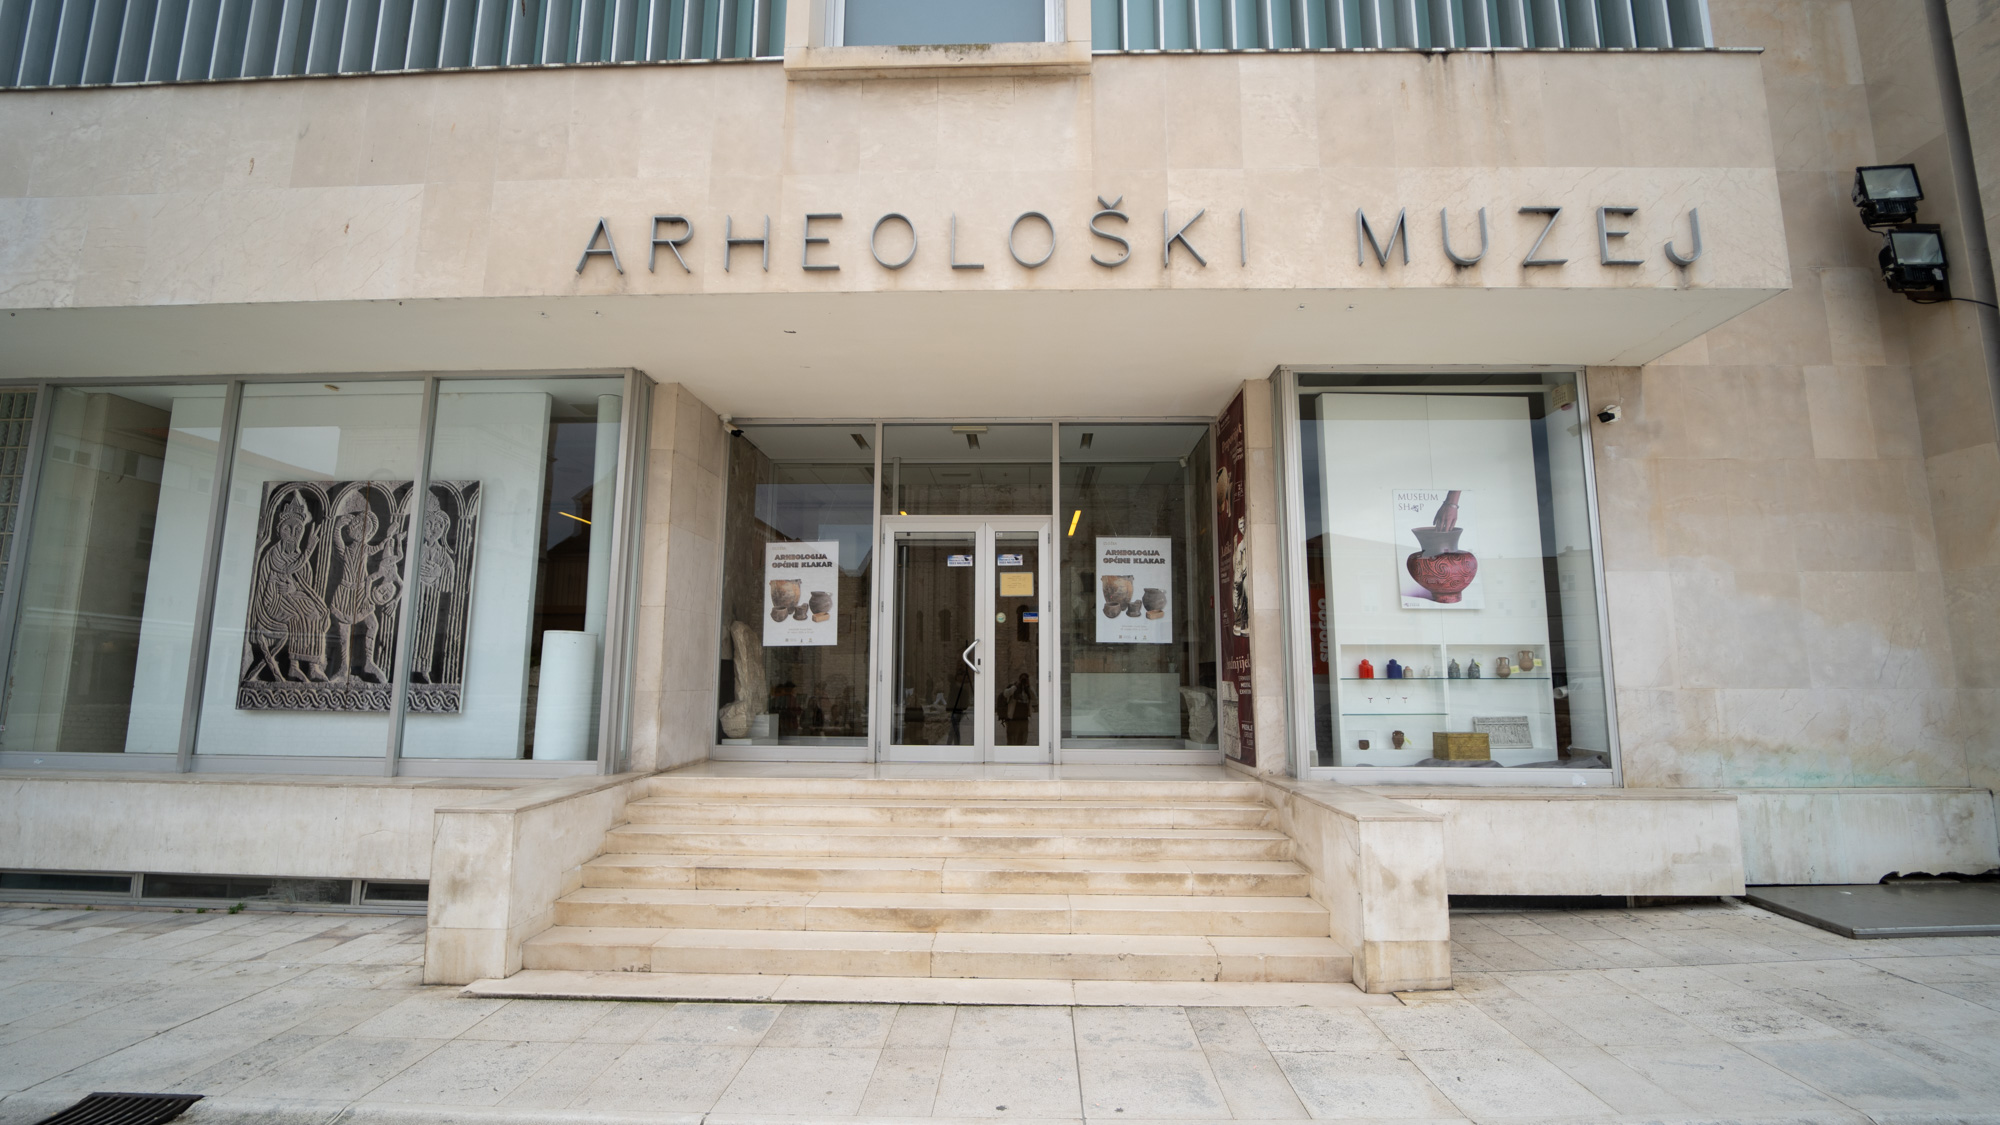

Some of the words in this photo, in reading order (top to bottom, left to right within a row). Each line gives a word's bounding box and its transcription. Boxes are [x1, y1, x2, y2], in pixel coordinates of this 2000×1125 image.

[575, 195, 1246, 275] ARHEOLOŠKI
[1356, 206, 1702, 267] MUZEJ
[1398, 493, 1439, 501] MUSEUM
[1105, 549, 1160, 557] ARHEOLOGIJA
[1103, 556, 1131, 564] OPĆINE
